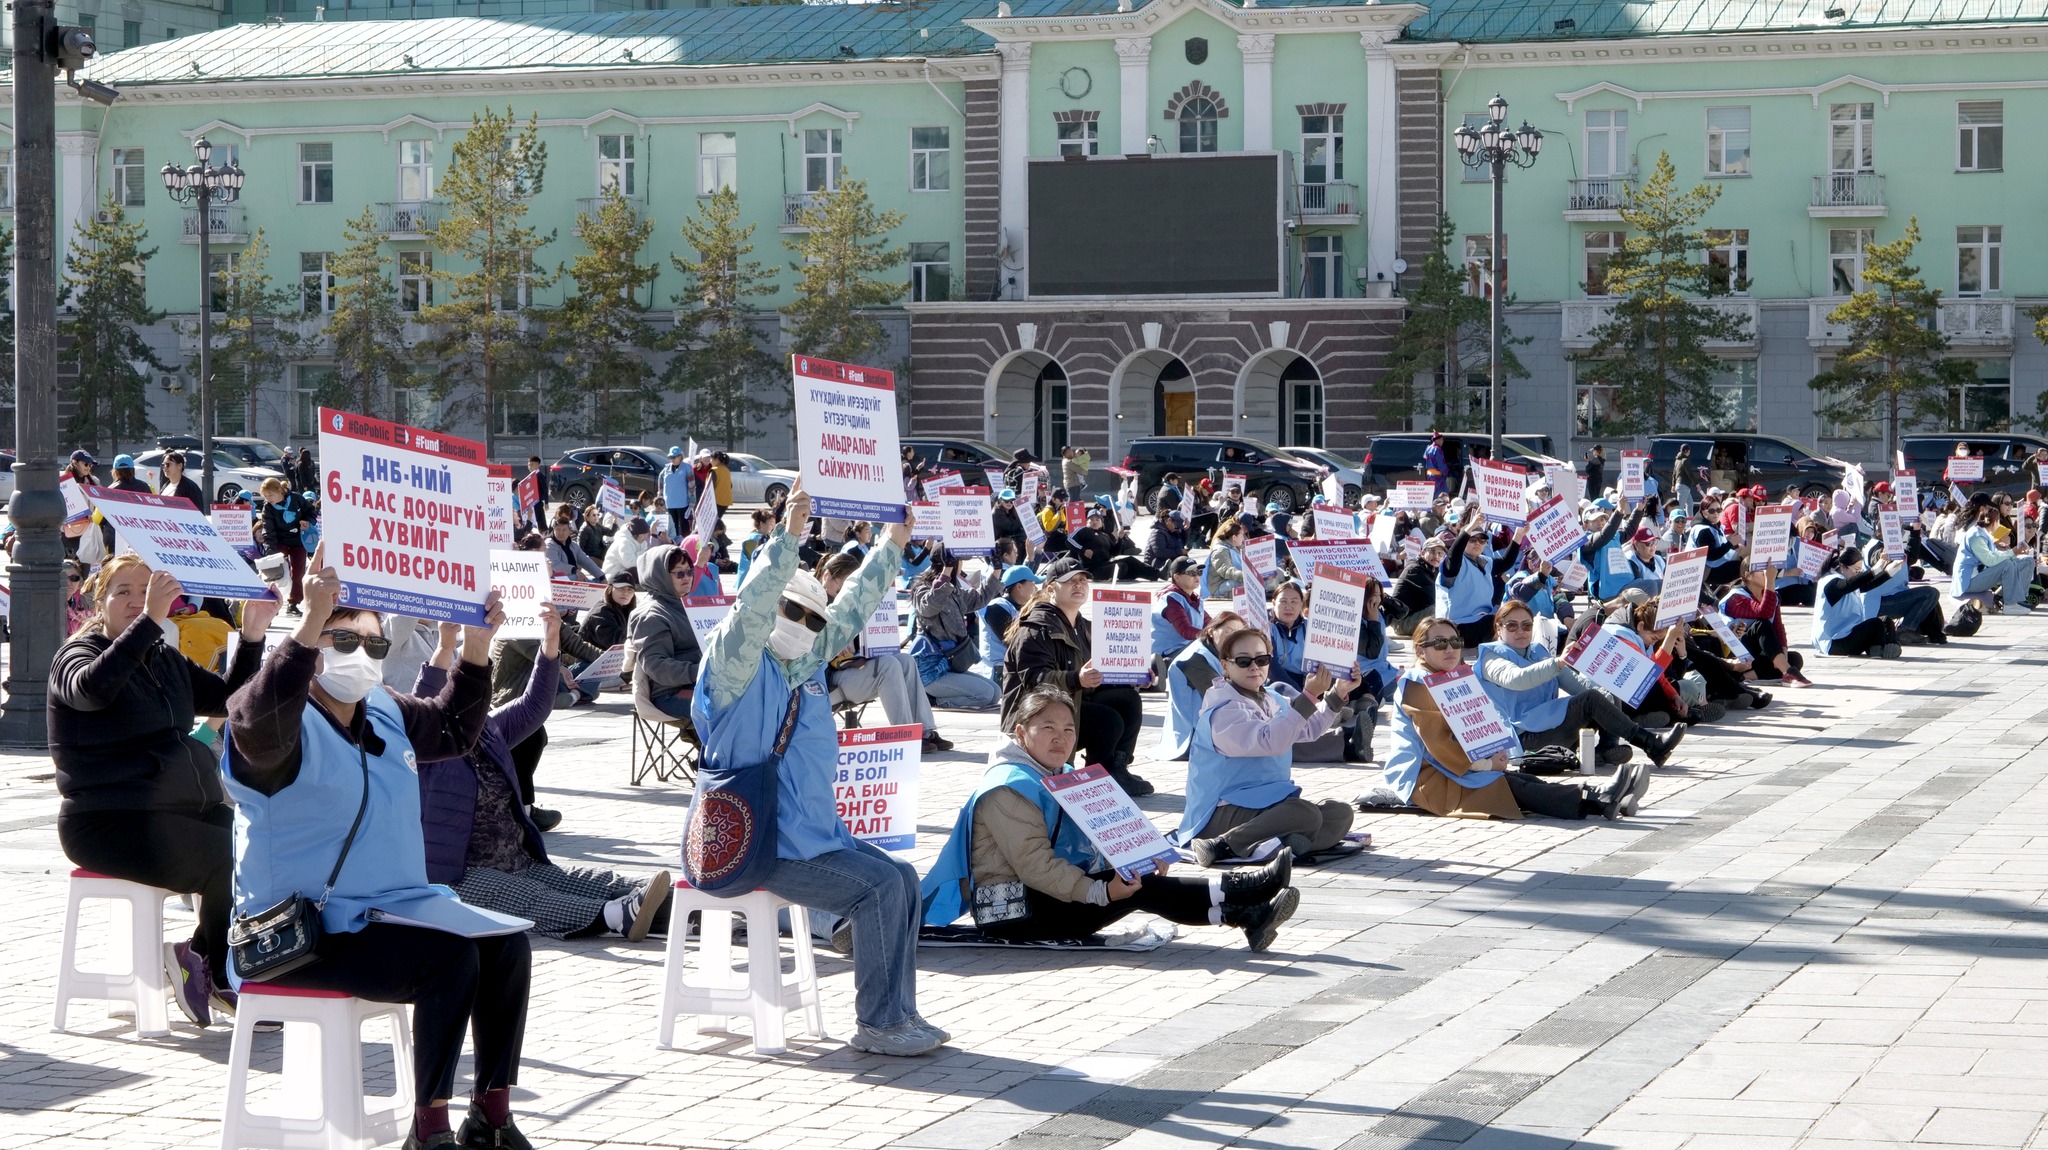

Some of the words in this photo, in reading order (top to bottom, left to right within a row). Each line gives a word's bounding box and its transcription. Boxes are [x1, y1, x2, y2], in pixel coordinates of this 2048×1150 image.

[810, 389, 846, 408] ХҮҮХДИЙН
[847, 395, 881, 412] ИРЭЭДҮЙГ
[824, 411, 870, 430] БҮТЭЭГЧДИЙН
[348, 420, 390, 441] #GoPublic
[415, 435, 476, 460] #FundEducation
[821, 433, 876, 456] АМЬДРАЛЫГ
[362, 454, 452, 495] ДНБ-НИЙ
[818, 456, 870, 481] САЙЖРУУЛ
[873, 466, 885, 482] !!!
[1484, 474, 1522, 489] ХӨДӨЛМӨРӨӨ
[327, 470, 396, 514] 6-ГААС
[403, 496, 485, 531] ДООШГҮЙ
[1486, 486, 1520, 500] ШУДАРГААР
[1487, 498, 1519, 512] ҮНЭЛҮҮЛЬЕ
[111, 513, 181, 534] ХАНГАЛТТАЙ
[180, 522, 218, 537] ТӨСӨВ
[954, 518, 982, 528] АМЬДРАЛЫГ
[1530, 526, 1550, 543] 6-ГААС
[1550, 510, 1573, 531] ДООШГҮЙ
[1534, 508, 1560, 530] ДНБ-НИЙ
[150, 535, 210, 552] ЧАНАРТАЙ
[369, 516, 450, 553] ХУВИЙГ
[952, 529, 978, 539] САЙЖРУУЛ
[1543, 528, 1580, 556] БОЛОВСРОЛД
[1546, 525, 1568, 544] ХУВИЙГ
[154, 552, 238, 572] БОЛОВСРОЛ!!!!
[342, 543, 476, 592] БОЛОВСРОЛД
[502, 562, 540, 573] ЦАЛИНГ
[1670, 566, 1699, 578] БОЛОВСРОЛЫН
[1666, 574, 1700, 590] САНХҮҮЖИЛТИЙГ
[356, 587, 389, 599] МОНГОЛЫН
[390, 592, 426, 606] БОЛОВСРОЛ,
[426, 598, 454, 610] ШИНЖЛЭХ
[454, 602, 476, 614] УХААНЫ
[1320, 590, 1356, 608] БОЛОВСРОЛЫН
[1664, 584, 1699, 600] НЭМЭГДҮҮЛЭХИЙГ
[356, 596, 398, 610] ҮЙЛДВЭРЧНИЙ
[398, 603, 428, 615] ЭВЛЭЛИЙН
[428, 608, 452, 619] ХОЛБОО
[1104, 606, 1122, 616] АВДАГ
[1124, 608, 1142, 617] ЦАЛИН
[1662, 599, 1682, 610] ШААРДАЖ
[1682, 595, 1696, 604] БАЙНА
[1314, 604, 1357, 623] САНХҮҮЖИЛТИЙГ
[1104, 619, 1143, 630] ХҮРЭЛЦЭХГҮЙ
[1312, 618, 1356, 638] НЭМЭГДҮҮЛЭХИЙГ
[1106, 632, 1141, 642] АМЬДРАЛЫН
[1310, 633, 1336, 648] ШААРДАЖ
[1337, 638, 1354, 652] БАЙНА
[1109, 645, 1138, 654] БАТАЛГАА
[1586, 648, 1610, 676] ХАНГАЛТТАЙ
[1603, 636, 1619, 652] ТӨСӨВ
[1101, 656, 1144, 668] ХАНГАГДАХГҮЙ
[1604, 652, 1625, 675] ЧАНАРТАЙ
[1444, 681, 1472, 702] ДНБ-НИЙ
[1440, 702, 1464, 718] 6-ГААС
[1463, 692, 1490, 713] ДООШГҮЙ
[1460, 709, 1486, 728] ХУВИЙГ
[853, 730, 912, 742] #FundEducation
[1461, 721, 1503, 744] БОЛОВСРОЛД
[855, 766, 887, 781] БОЛ
[862, 782, 898, 798] БИШ
[1062, 790, 1086, 804] ҮНИЙН
[1083, 780, 1116, 799] ӨСӨЛТТЭЙ
[1080, 797, 1118, 815] УЯЛДУУЛАН
[1085, 816, 1106, 830] ЦАЛИН
[1106, 806, 1134, 824] ХӨЛСИЙГ
[1095, 818, 1146, 843] НЭМЭГДҮҮЛЭХИЙГ
[1103, 838, 1136, 856] ШААРДАЖ
